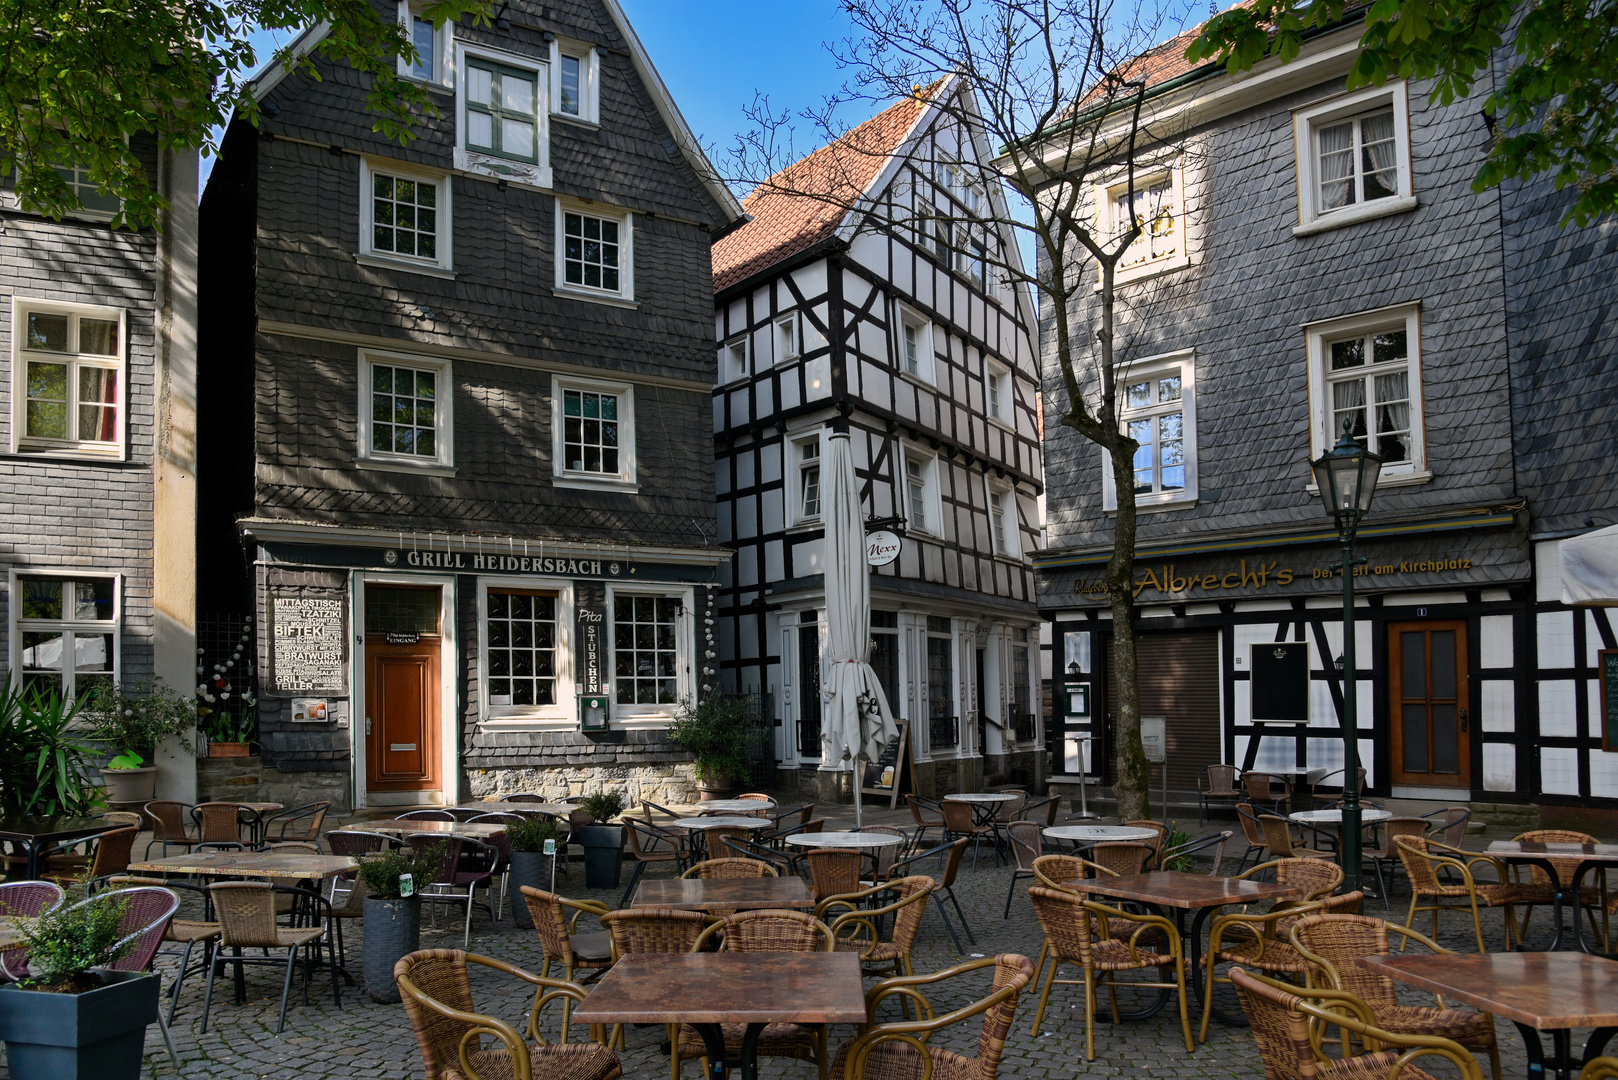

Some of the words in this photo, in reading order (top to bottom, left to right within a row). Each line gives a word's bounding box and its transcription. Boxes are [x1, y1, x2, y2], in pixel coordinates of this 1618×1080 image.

[867, 543, 897, 556] Mexx
[407, 551, 465, 568] GRILL
[474, 555, 602, 575] HEIDERSBACH
[1374, 565, 1394, 575] am
[1400, 559, 1472, 573] Kirchplatz
[1132, 558, 1293, 598] Albrecht's
[274, 598, 342, 607] MITTAGSTISCH
[301, 610, 342, 618] TZATZIKI
[577, 608, 602, 622] Pita
[274, 626, 325, 636] BIFTEKI
[284, 652, 342, 660] BRATWURST
[588, 625, 598, 693] STÜBCHEN
